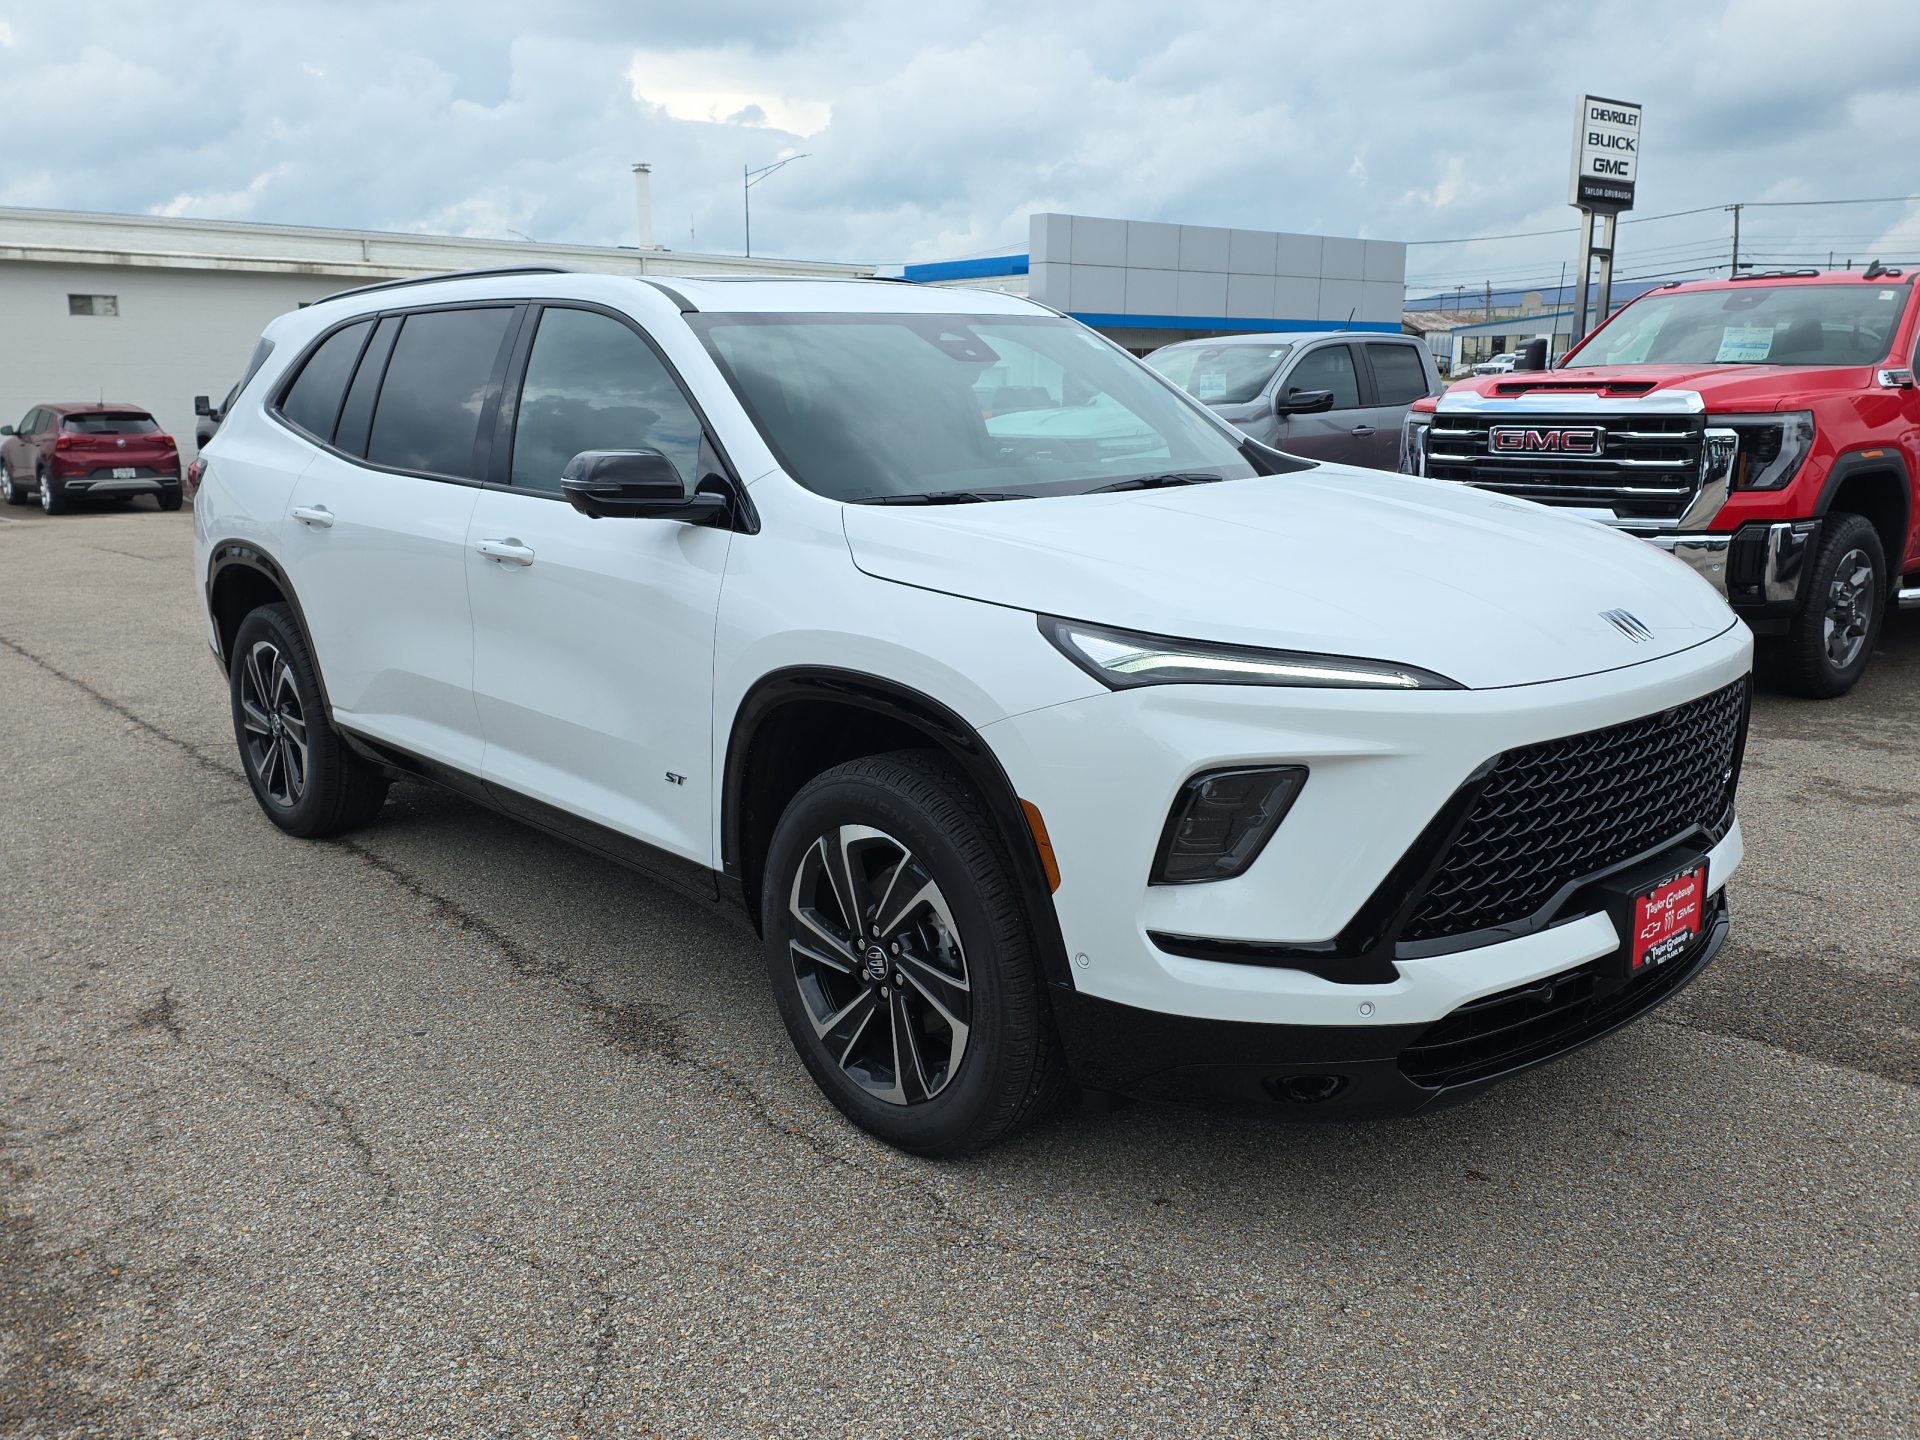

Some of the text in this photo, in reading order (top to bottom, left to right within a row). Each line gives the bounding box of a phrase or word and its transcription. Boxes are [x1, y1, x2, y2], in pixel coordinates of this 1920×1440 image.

[1591, 107, 1638, 126] CHEVROLET
[1588, 132, 1636, 152] BUICK
[1593, 157, 1629, 176] GMC
[1585, 187, 1632, 200] TAYLOR GRUBAUGH
[1495, 430, 1595, 451] GMC
[664, 771, 688, 786] ST
[1645, 883, 1695, 920] Taylor Grubaugh
[1676, 902, 1696, 920] GMC
[1651, 943, 1667, 960] Taylor
